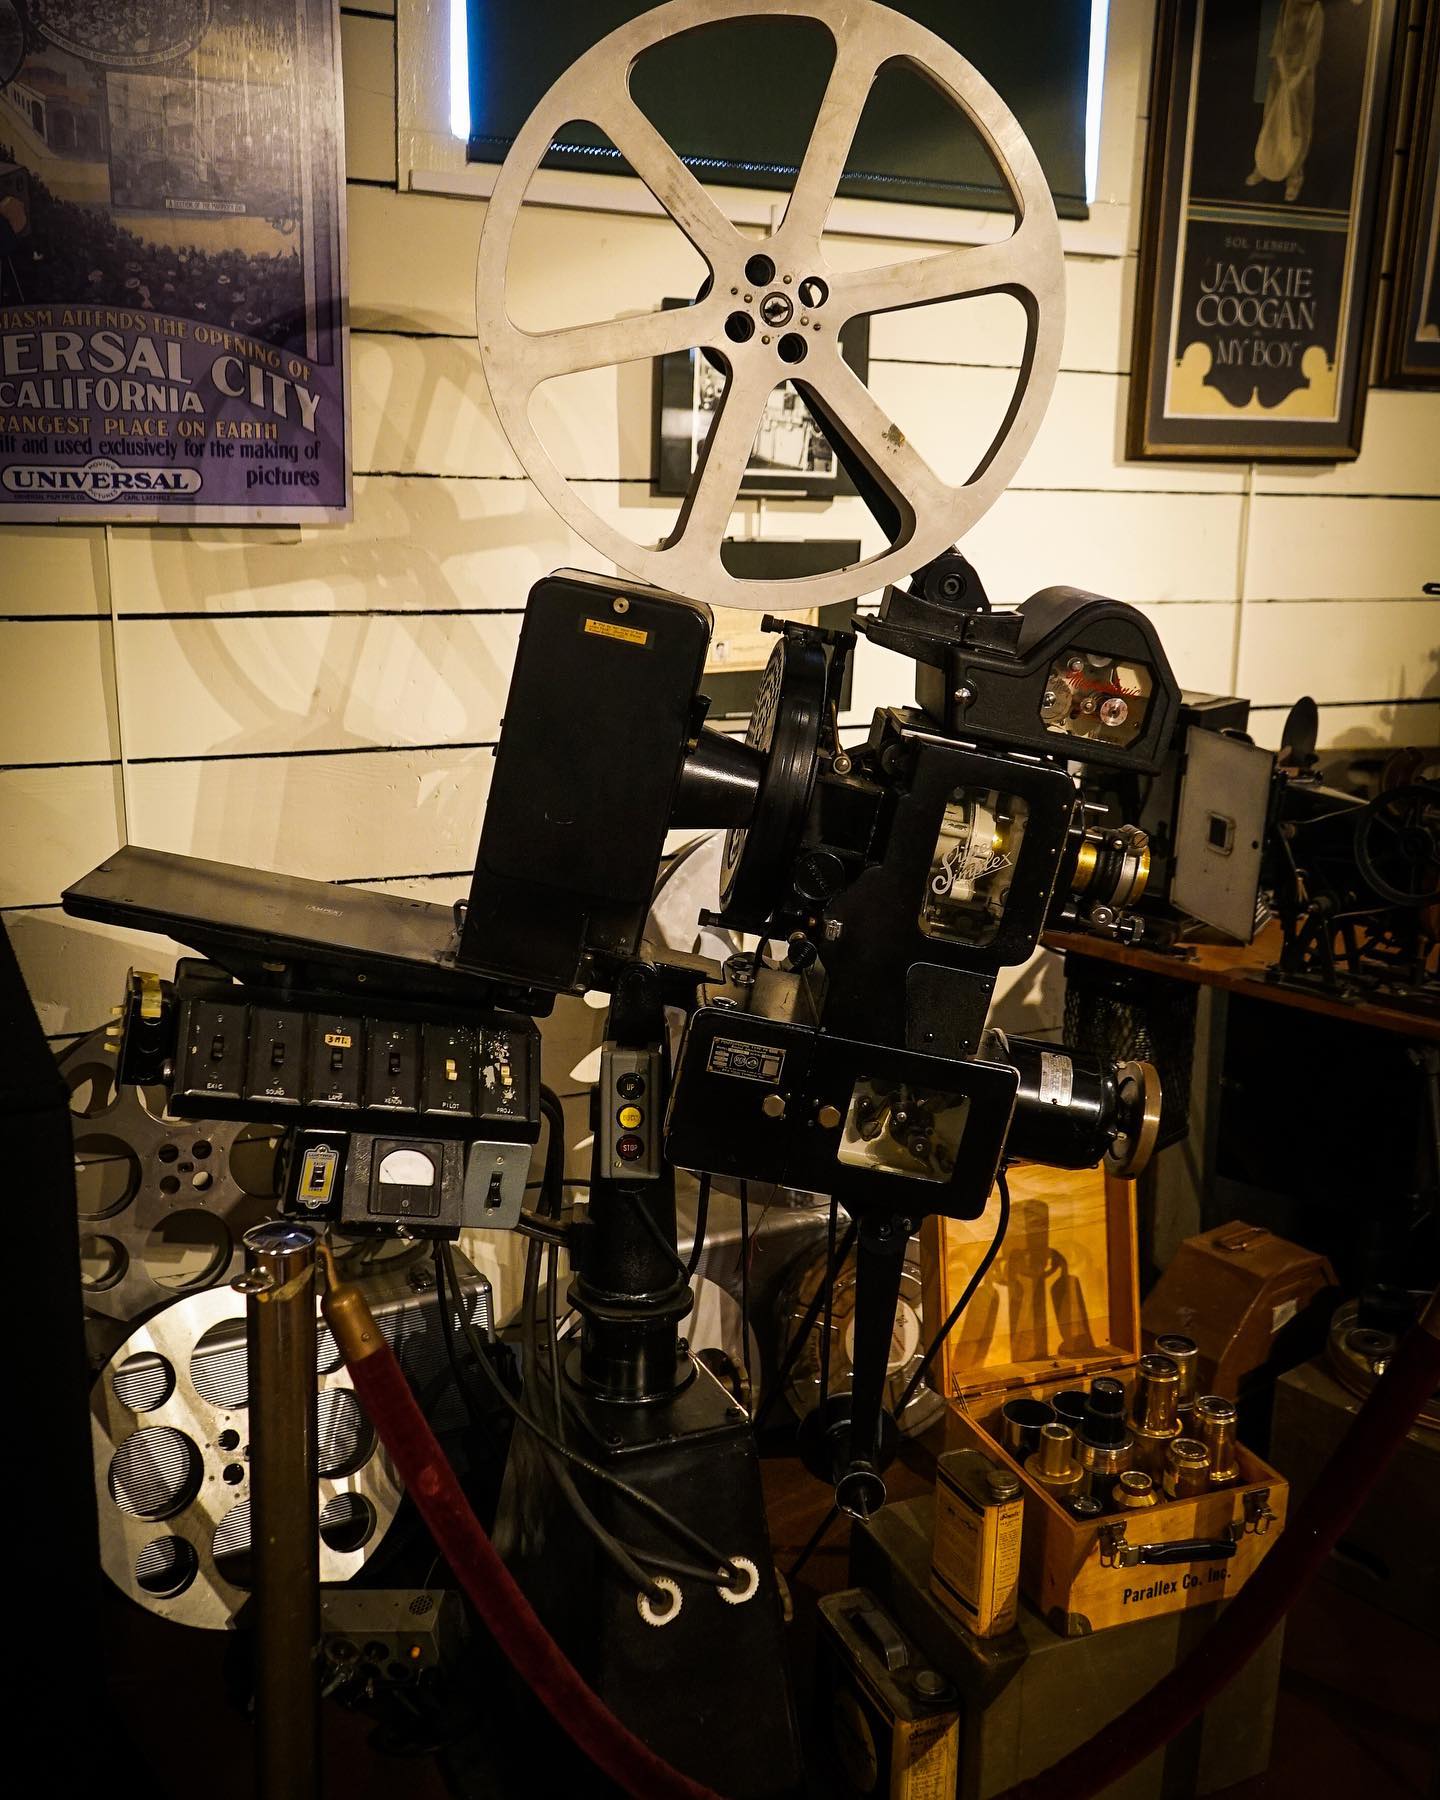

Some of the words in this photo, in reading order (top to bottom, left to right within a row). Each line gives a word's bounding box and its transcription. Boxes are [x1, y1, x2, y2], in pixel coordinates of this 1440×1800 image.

[1200, 262, 1314, 298] JACKIE
[1196, 294, 1317, 330] COOGAN
[0, 310, 53, 329] IASM
[62, 310, 147, 332] ATTENDS
[152, 317, 188, 340] THE
[193, 326, 281, 369] OPENING
[288, 358, 312, 381] OF
[1216, 338, 1250, 366] MY
[1251, 339, 1300, 368] BOY
[0, 377, 205, 415] CALIFORNIA
[3, 330, 193, 385] ERSAL
[211, 355, 321, 434] CITY
[104, 417, 170, 437] PLACE
[177, 420, 206, 438] ON
[215, 421, 279, 440] EARTH
[22, 436, 48, 454] and
[54, 437, 93, 455] used
[99, 437, 178, 461] exclusively
[184, 440, 206, 458] for
[210, 441, 235, 458] the
[240, 441, 299, 463] making
[304, 441, 321, 460] of
[12, 471, 189, 490] UNIVERSAL
[246, 465, 320, 489] pictures
[626, 1083, 635, 1092] UP
[442, 1101, 461, 1110] PILOT
[622, 1144, 638, 1152] STOP
[1122, 1579, 1178, 1605] Parallex
[1182, 1573, 1203, 1589] Co.
[1207, 1566, 1232, 1583] Inc.
